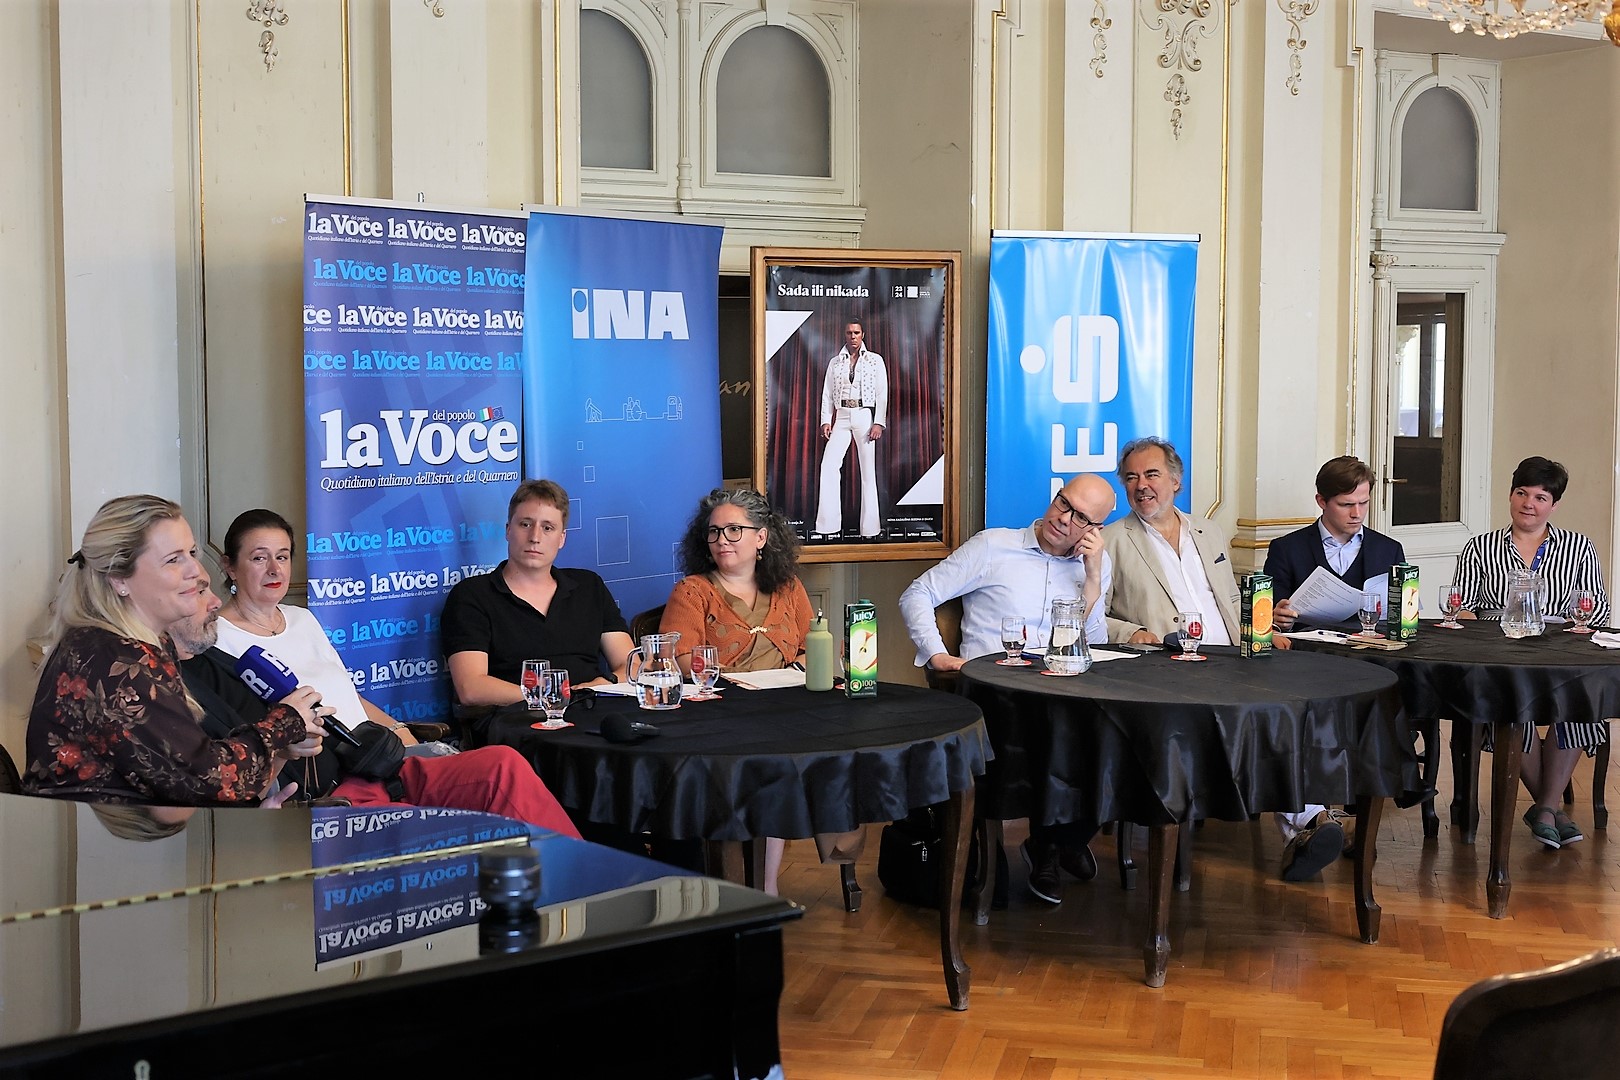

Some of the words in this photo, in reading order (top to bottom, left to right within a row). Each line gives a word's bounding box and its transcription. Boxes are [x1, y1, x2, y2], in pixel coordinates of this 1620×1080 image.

[778, 284, 809, 297] Sada
[811, 284, 824, 297] ili
[826, 284, 869, 298] nikada
[432, 410, 445, 420] del
[447, 409, 476, 423] popolo
[320, 409, 383, 468] la
[380, 410, 518, 465] Voce
[321, 475, 376, 491] Quotidiano
[378, 473, 413, 487] italiano
[415, 471, 454, 485] dell'Istria
[463, 470, 476, 482] del
[478, 470, 518, 483] Quarnero
[240, 668, 269, 696] R
